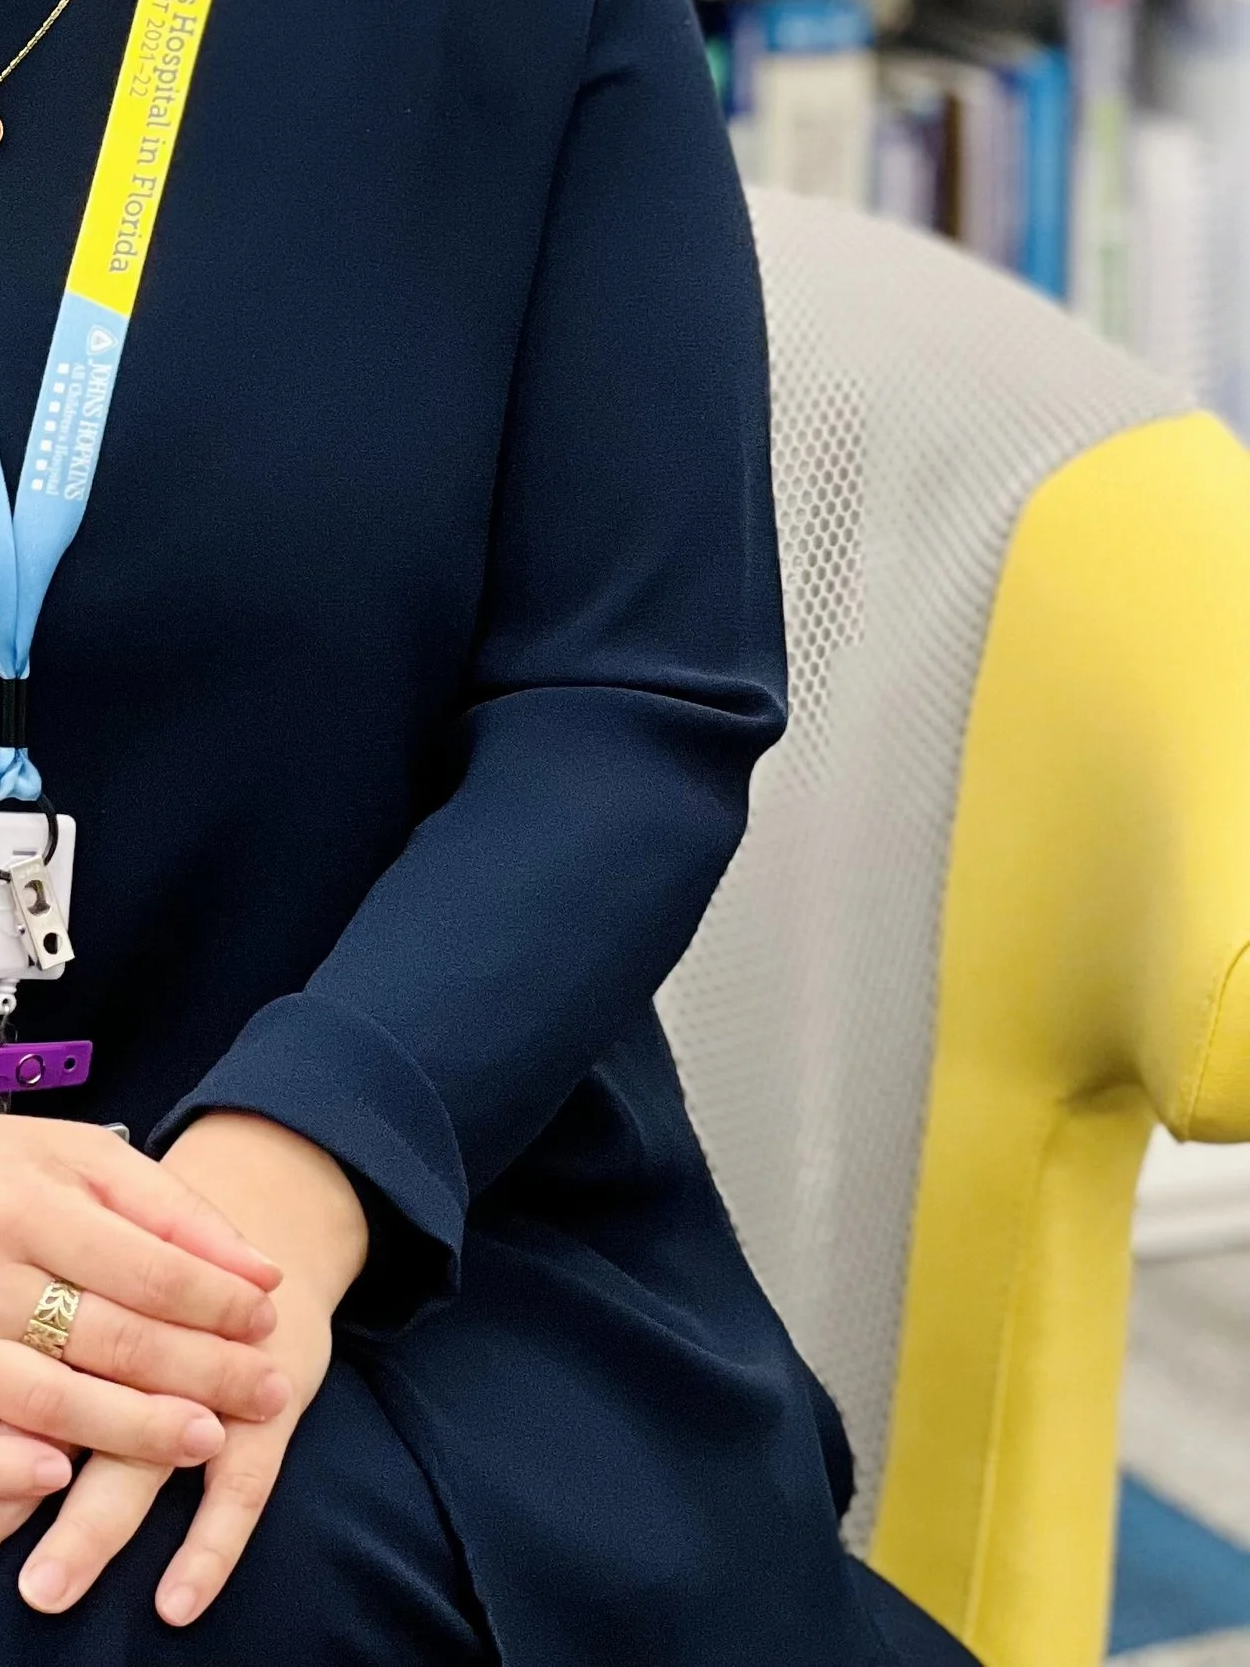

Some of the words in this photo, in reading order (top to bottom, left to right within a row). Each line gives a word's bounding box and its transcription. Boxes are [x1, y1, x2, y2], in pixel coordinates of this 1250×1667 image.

[146, 12, 197, 127] Hospital
[137, 136, 166, 165] in
[110, 174, 157, 273] Florida
[82, 358, 112, 418] JOHNS
[64, 420, 99, 501] HOPKINS
